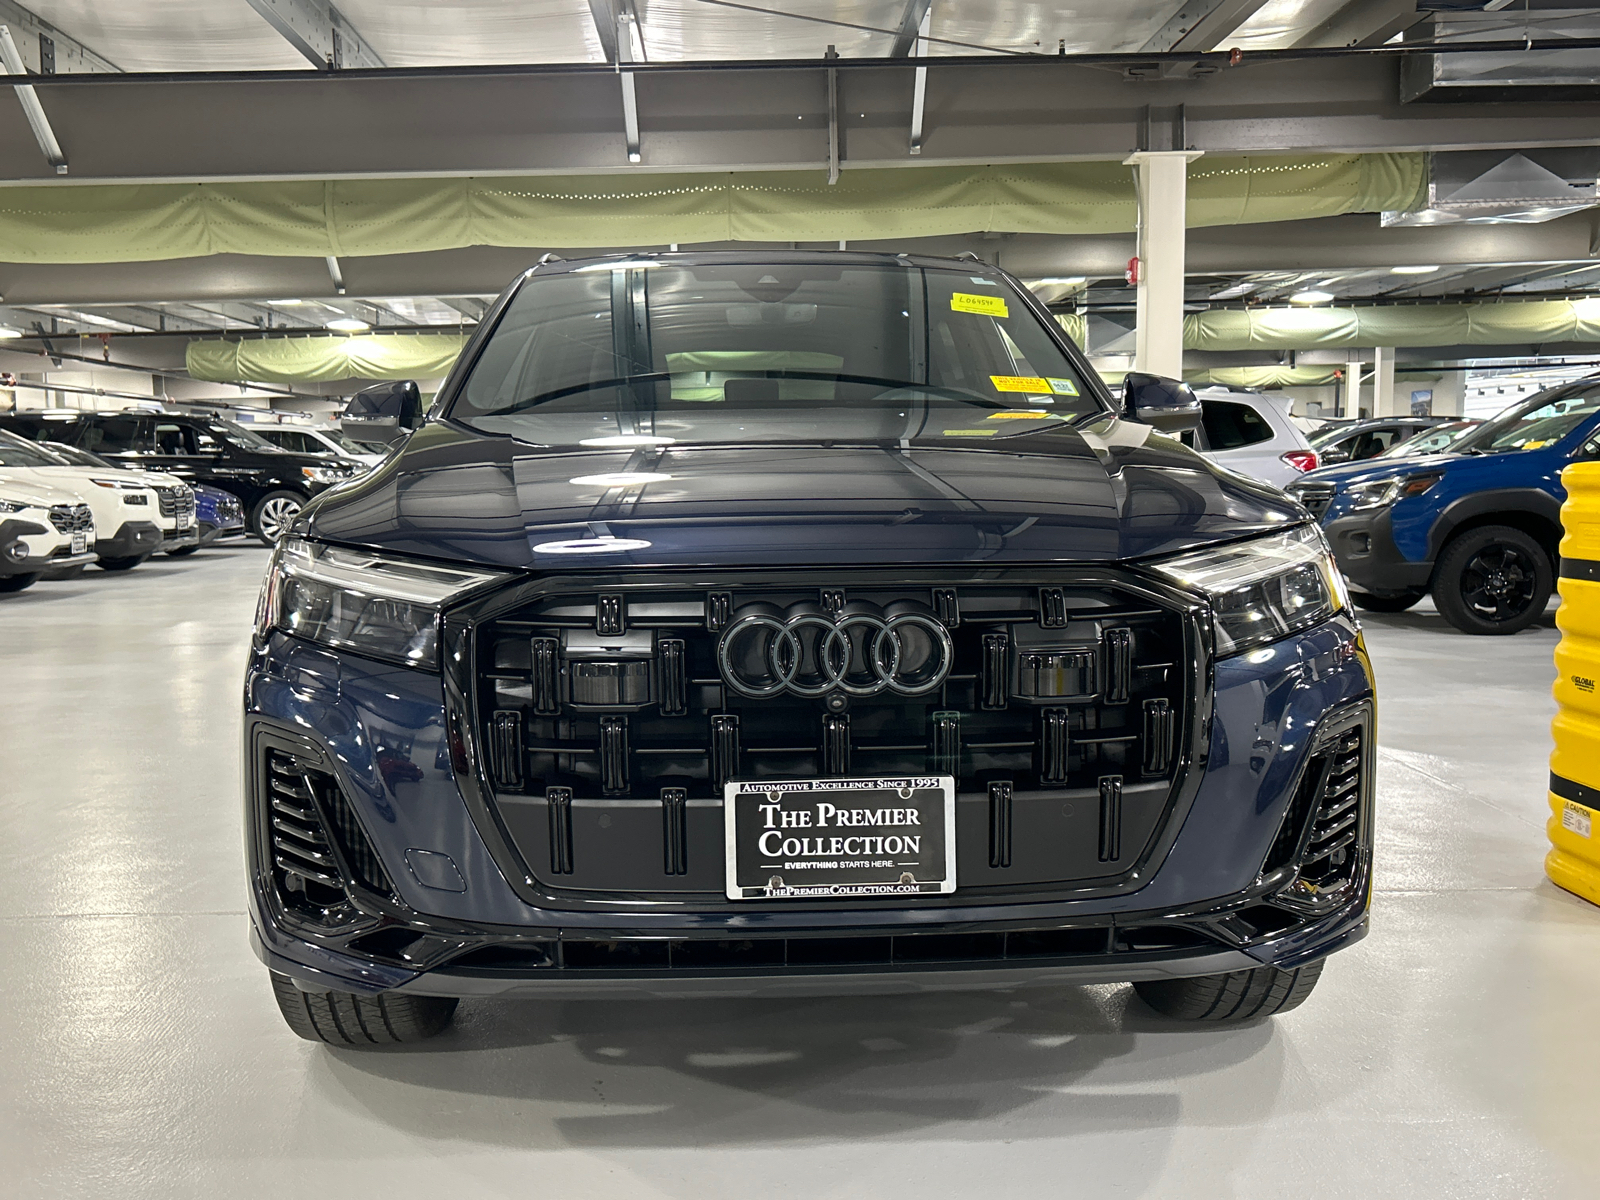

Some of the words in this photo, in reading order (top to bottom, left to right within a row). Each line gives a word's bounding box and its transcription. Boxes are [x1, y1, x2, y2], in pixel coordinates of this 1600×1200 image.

[1575, 676, 1595, 687] GLOBAL
[742, 782, 810, 792] AUTOMOTIVE
[812, 780, 874, 791] EXCELLENCE
[876, 779, 907, 789] SINCE
[910, 778, 938, 788] 1995
[758, 803, 812, 829] THE
[816, 803, 921, 827] PREMIER
[1570, 803, 1590, 818] CAUTION
[758, 830, 921, 857] COLLECTION
[785, 860, 838, 870] EVERYTHING
[839, 860, 870, 869] STARTS
[871, 860, 895, 868] HERE.
